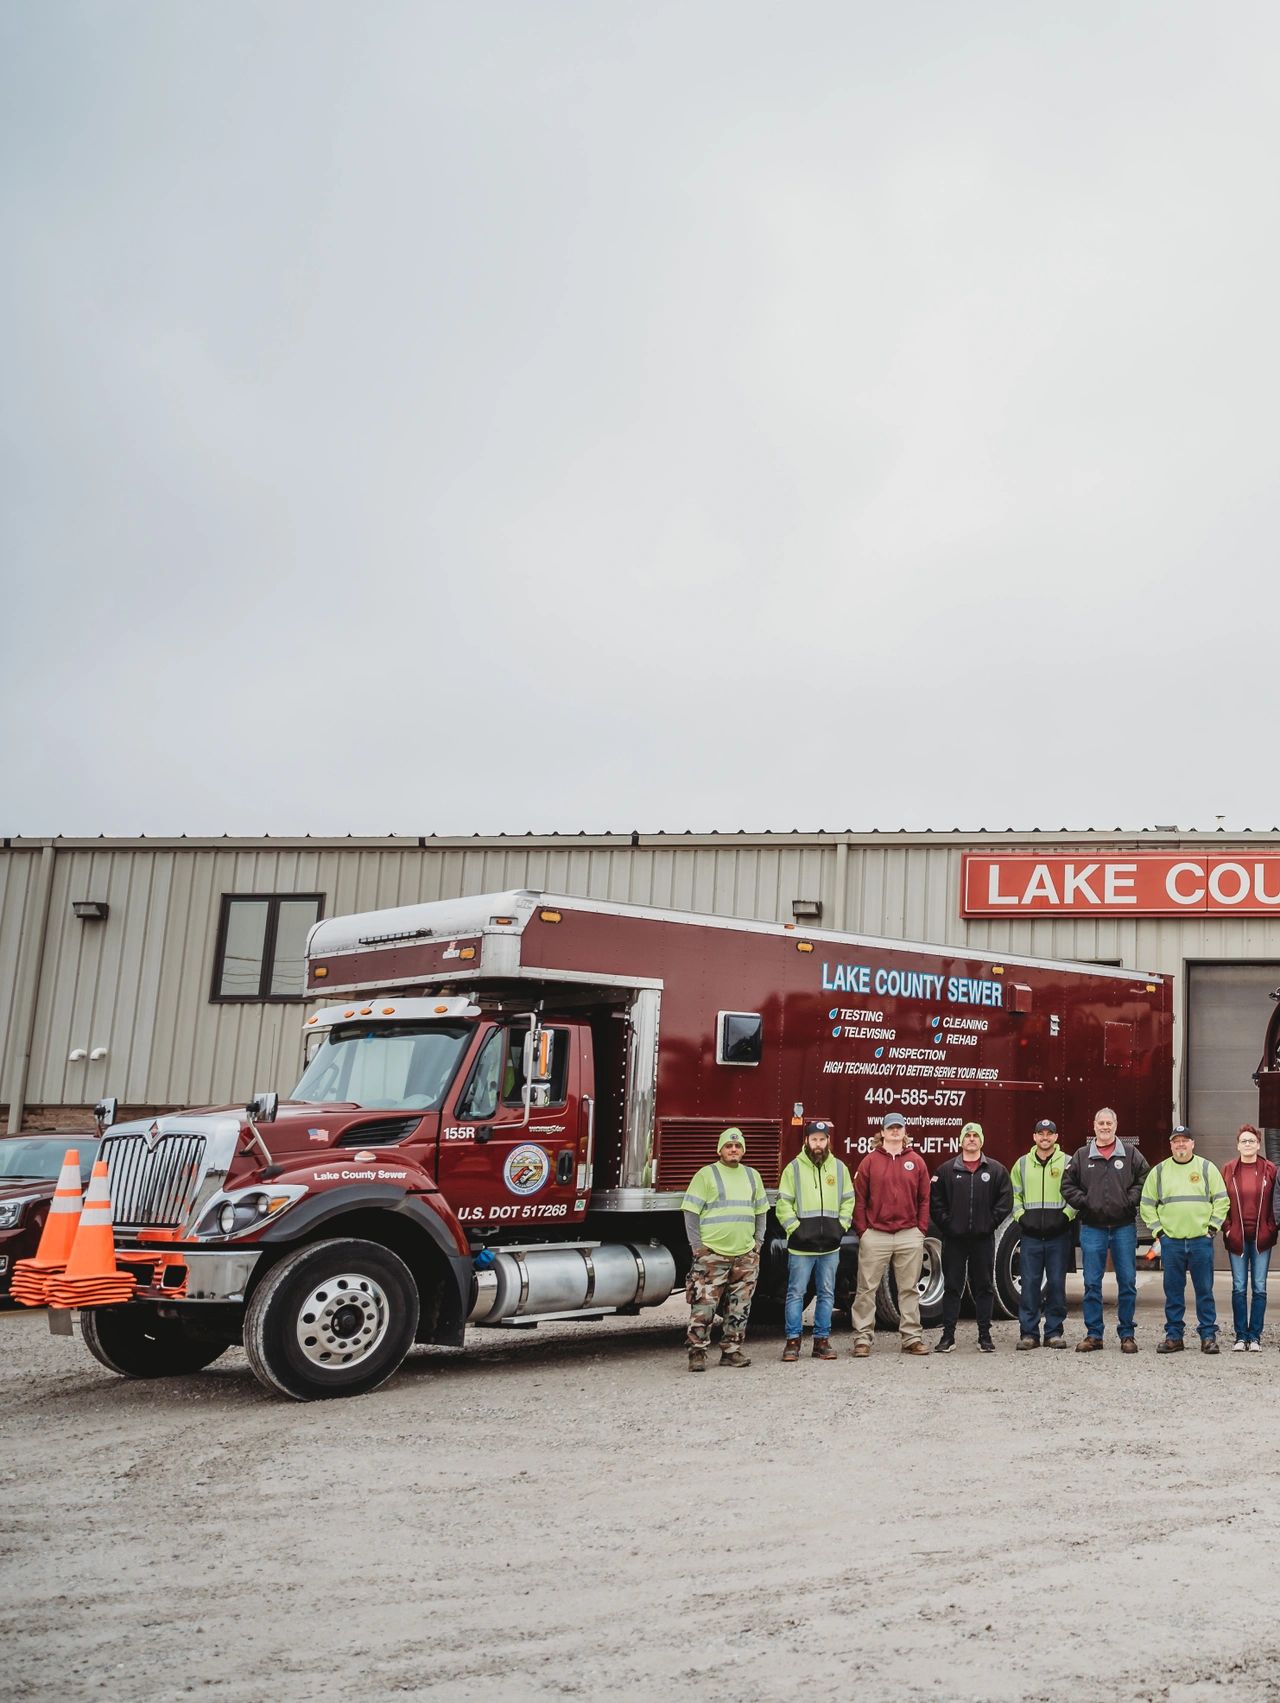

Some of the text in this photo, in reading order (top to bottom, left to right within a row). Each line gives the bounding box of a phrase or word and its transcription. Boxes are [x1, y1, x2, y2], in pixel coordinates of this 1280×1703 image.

[987, 864, 1138, 905] LAKE
[822, 962, 1003, 1007] LAKE COUNTY SEWER
[840, 1008, 884, 1023] TESTING
[942, 1016, 989, 1031] CLEANING
[844, 1026, 896, 1040] TELEVISING
[946, 1034, 978, 1046] REHAB
[888, 1047, 946, 1060] INSPECTION
[823, 1061, 999, 1080] HIGH TECHNOLOGY TO BETTER SERVE YOUR NEEDS
[864, 1087, 966, 1106] 440-585-5757
[443, 1126, 475, 1139] 155R
[313, 1169, 408, 1180] Lake County Sewer
[457, 1204, 568, 1220] U.S. DOT 517268
